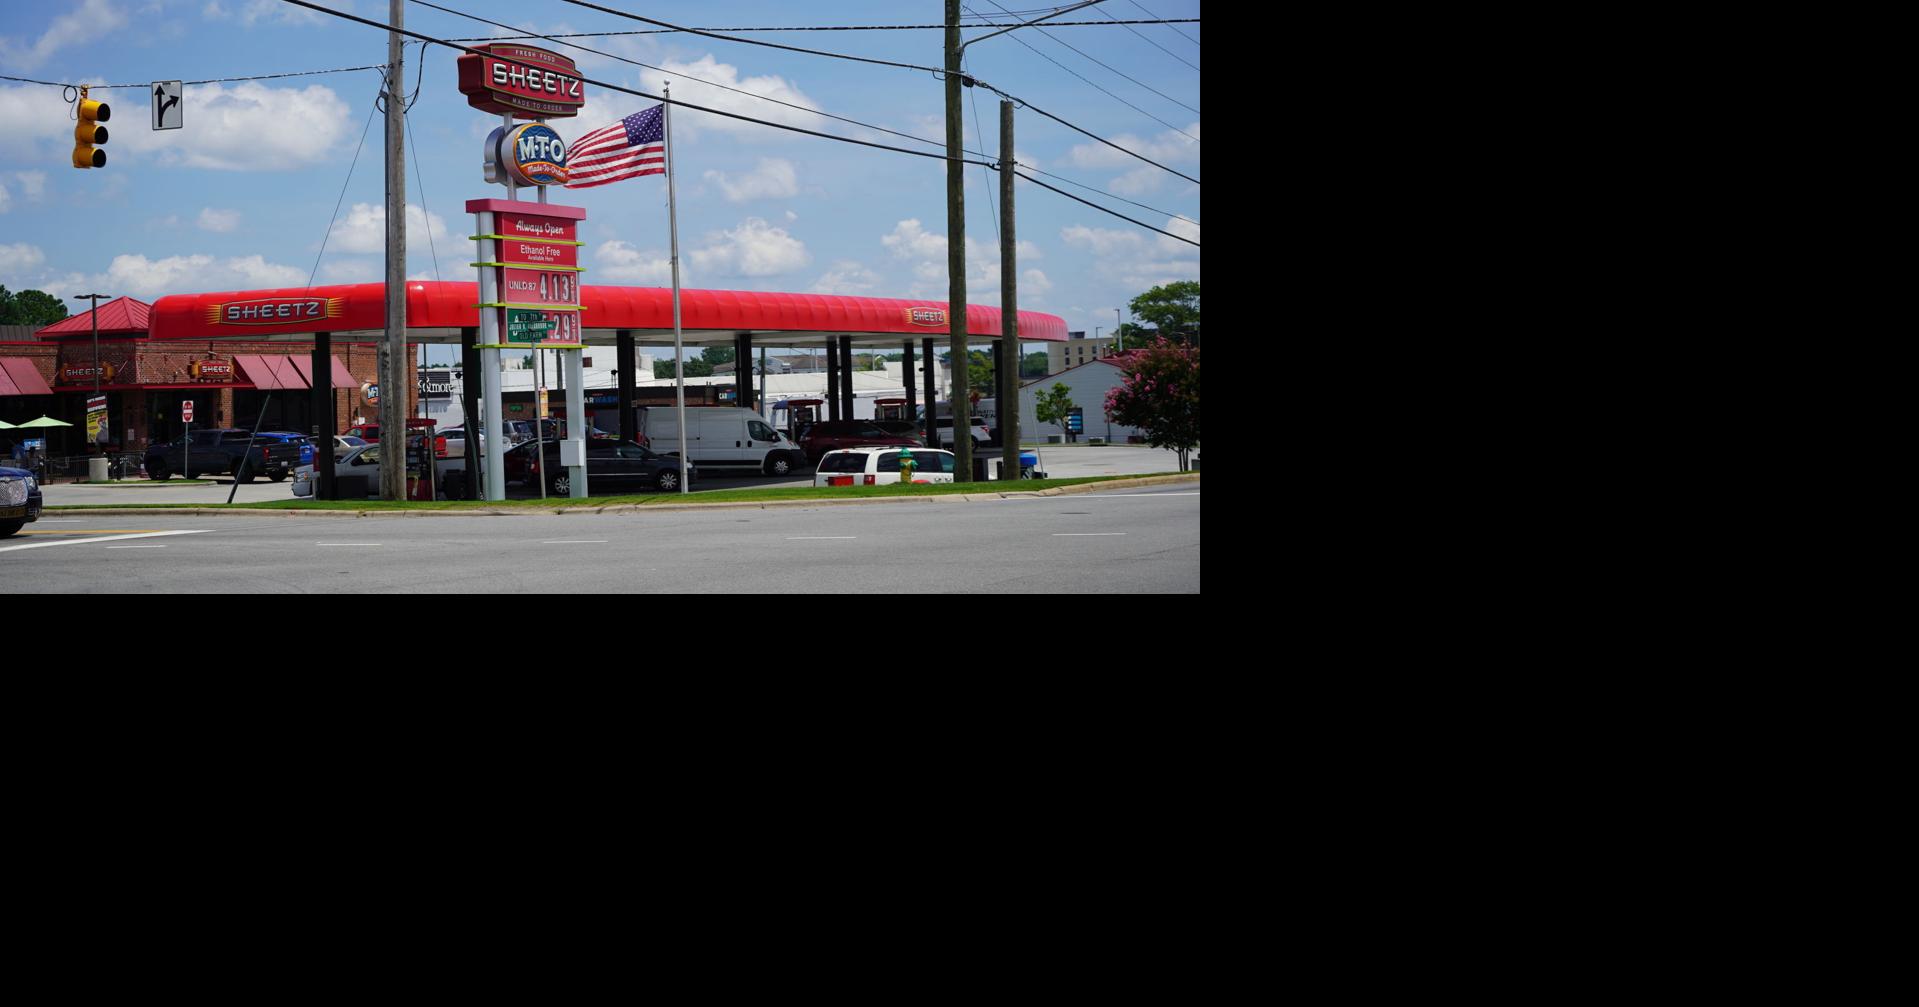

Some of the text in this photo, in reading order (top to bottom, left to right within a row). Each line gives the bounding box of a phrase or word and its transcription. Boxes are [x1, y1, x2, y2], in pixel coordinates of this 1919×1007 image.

[515, 49, 556, 62] FRESH FOOD
[493, 63, 580, 97] SHEETZ
[515, 219, 564, 236] Always Open
[520, 244, 560, 257] Ethanol Free
[509, 280, 528, 290] UNLD
[528, 282, 537, 291] 87
[227, 301, 320, 319] SHEETZ
[913, 310, 944, 322] SHEETZ
[66, 367, 104, 377] SHEETZ
[202, 366, 231, 374] SHEETZ
